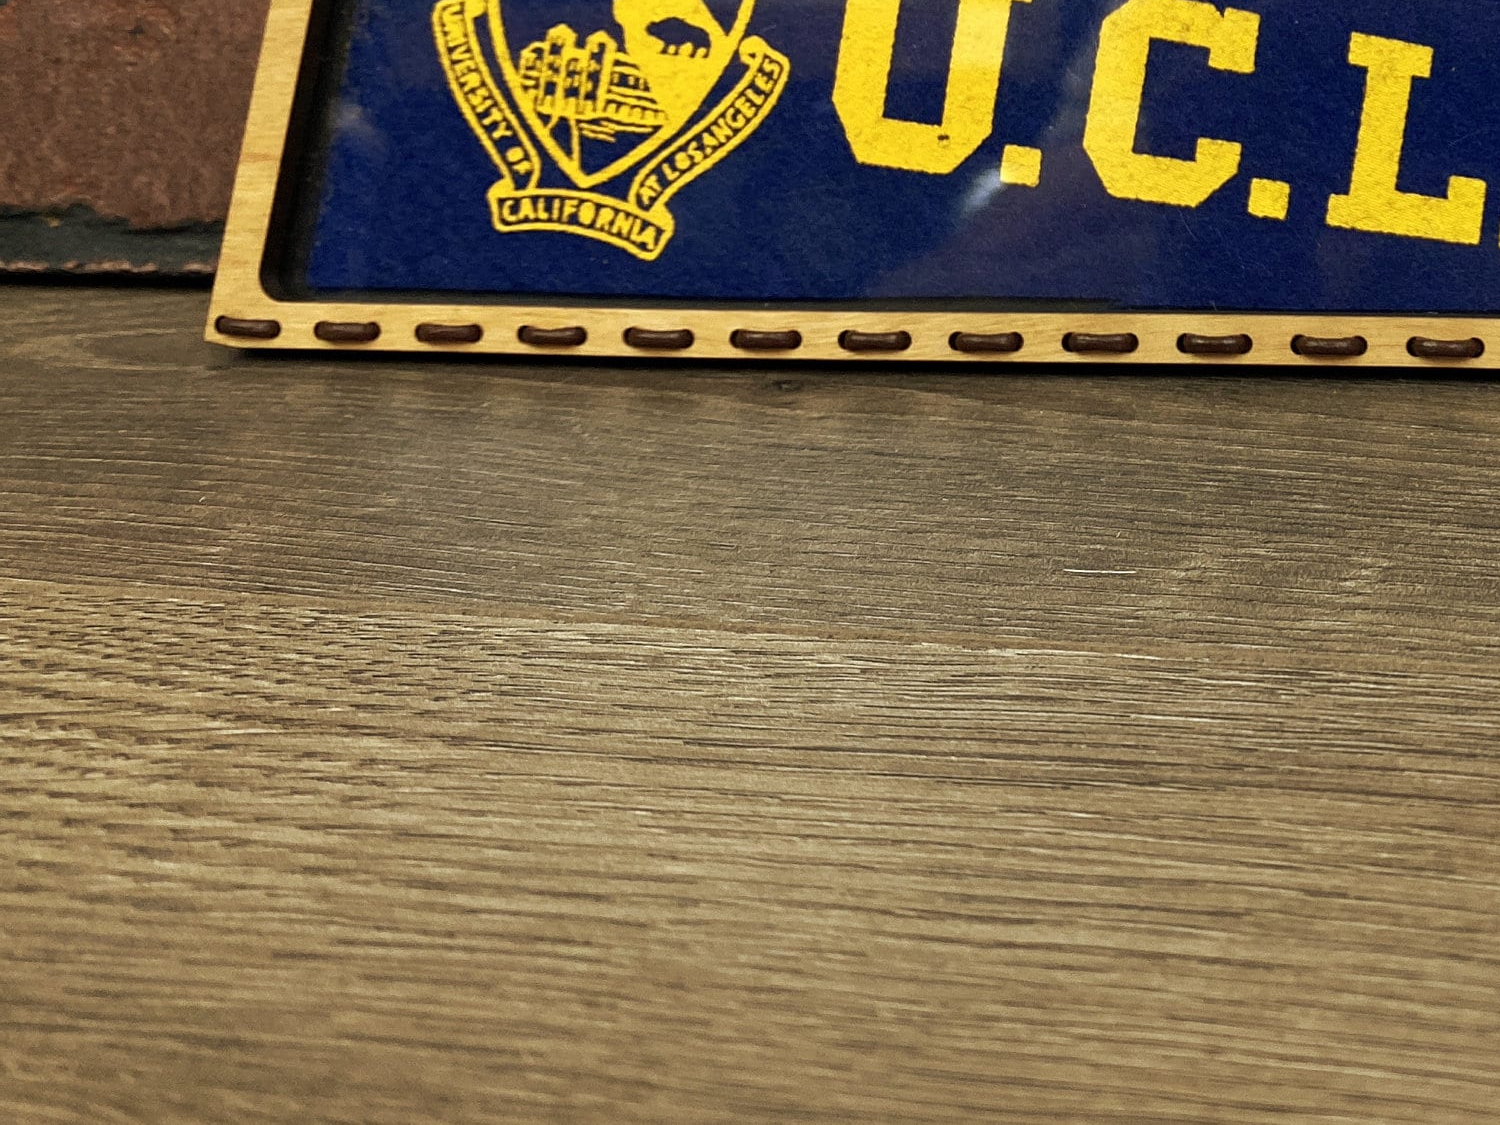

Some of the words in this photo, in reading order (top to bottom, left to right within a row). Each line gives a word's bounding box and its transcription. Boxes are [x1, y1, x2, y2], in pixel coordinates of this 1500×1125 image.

[442, 3, 513, 140] UNIVERSITY
[505, 145, 535, 175] OF
[638, 174, 663, 205] AT
[662, 141, 705, 181] LOS
[702, 57, 783, 156] ANGELES
[501, 197, 657, 250] CALIFORNIA
